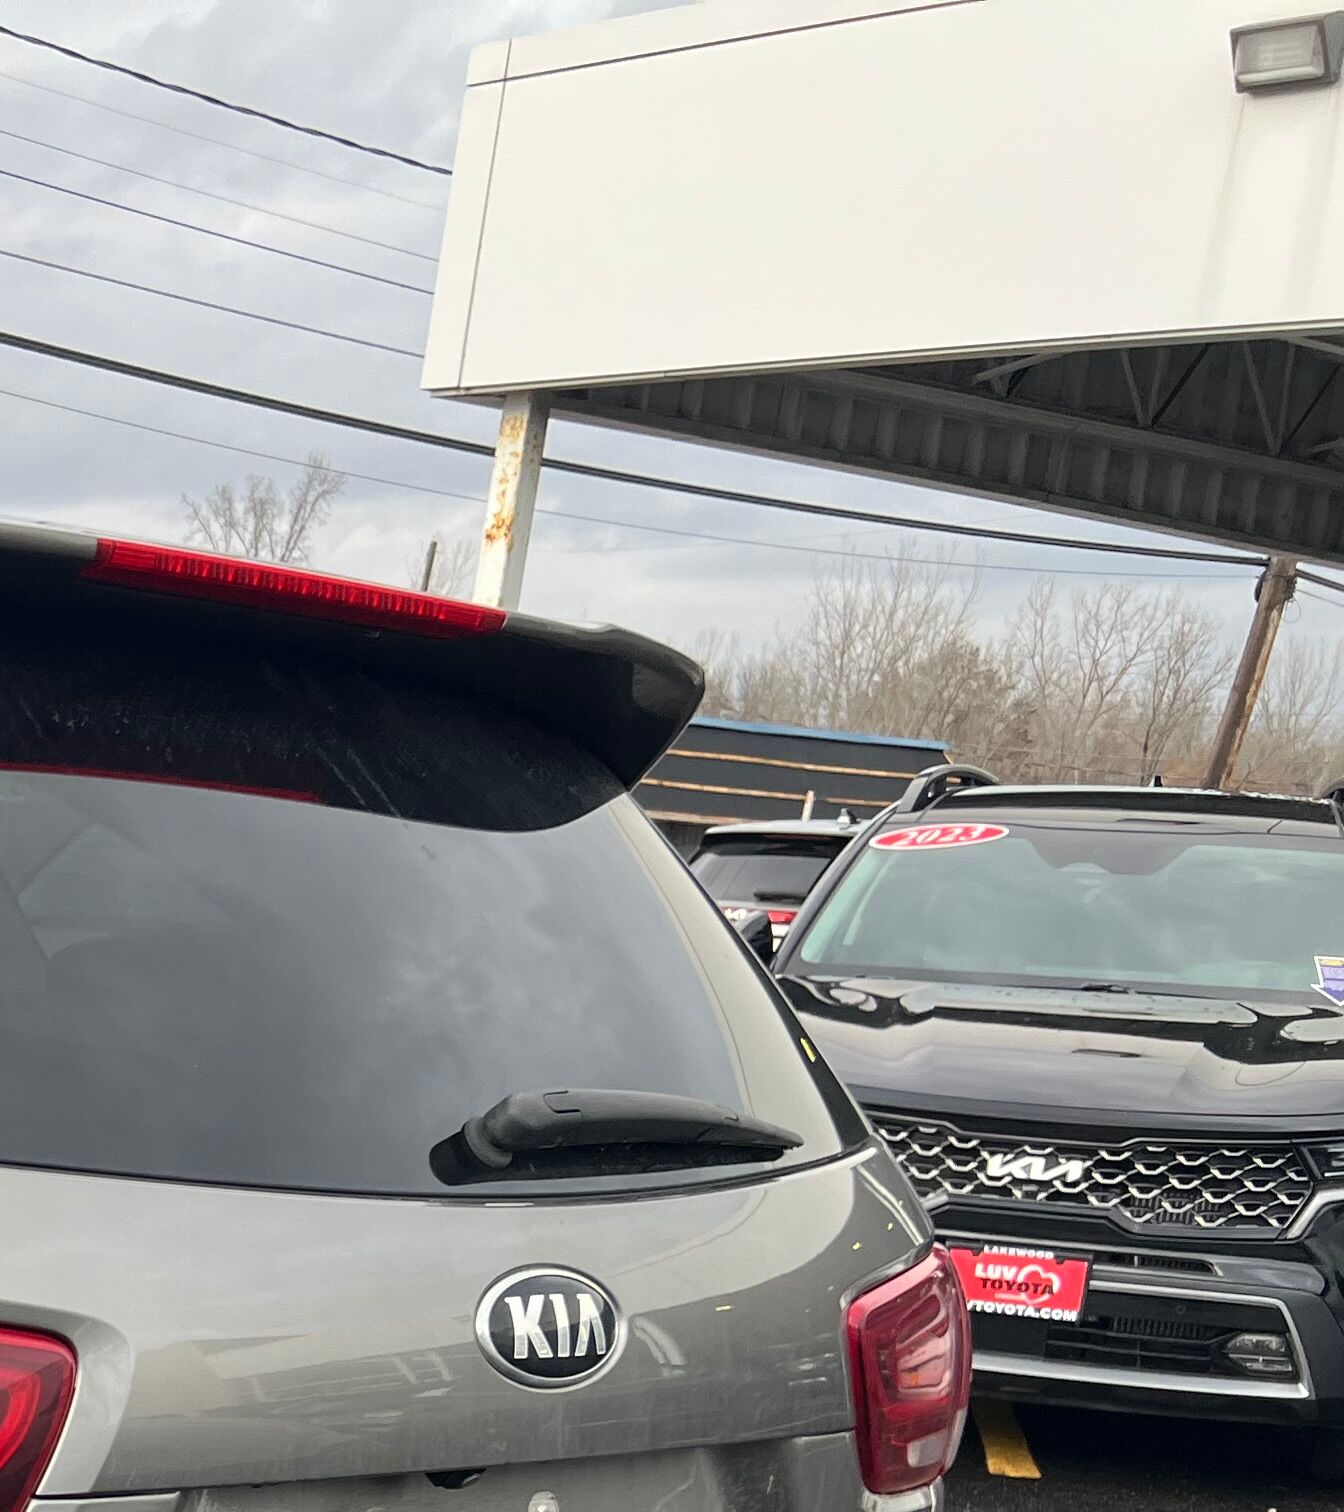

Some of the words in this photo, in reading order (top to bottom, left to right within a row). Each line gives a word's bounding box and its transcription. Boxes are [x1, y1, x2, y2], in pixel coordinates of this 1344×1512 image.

[891, 825, 986, 846] 2023
[974, 1263, 1018, 1280] LUV
[981, 1278, 1054, 1296] TOYOTA
[504, 1293, 608, 1359] KIA
